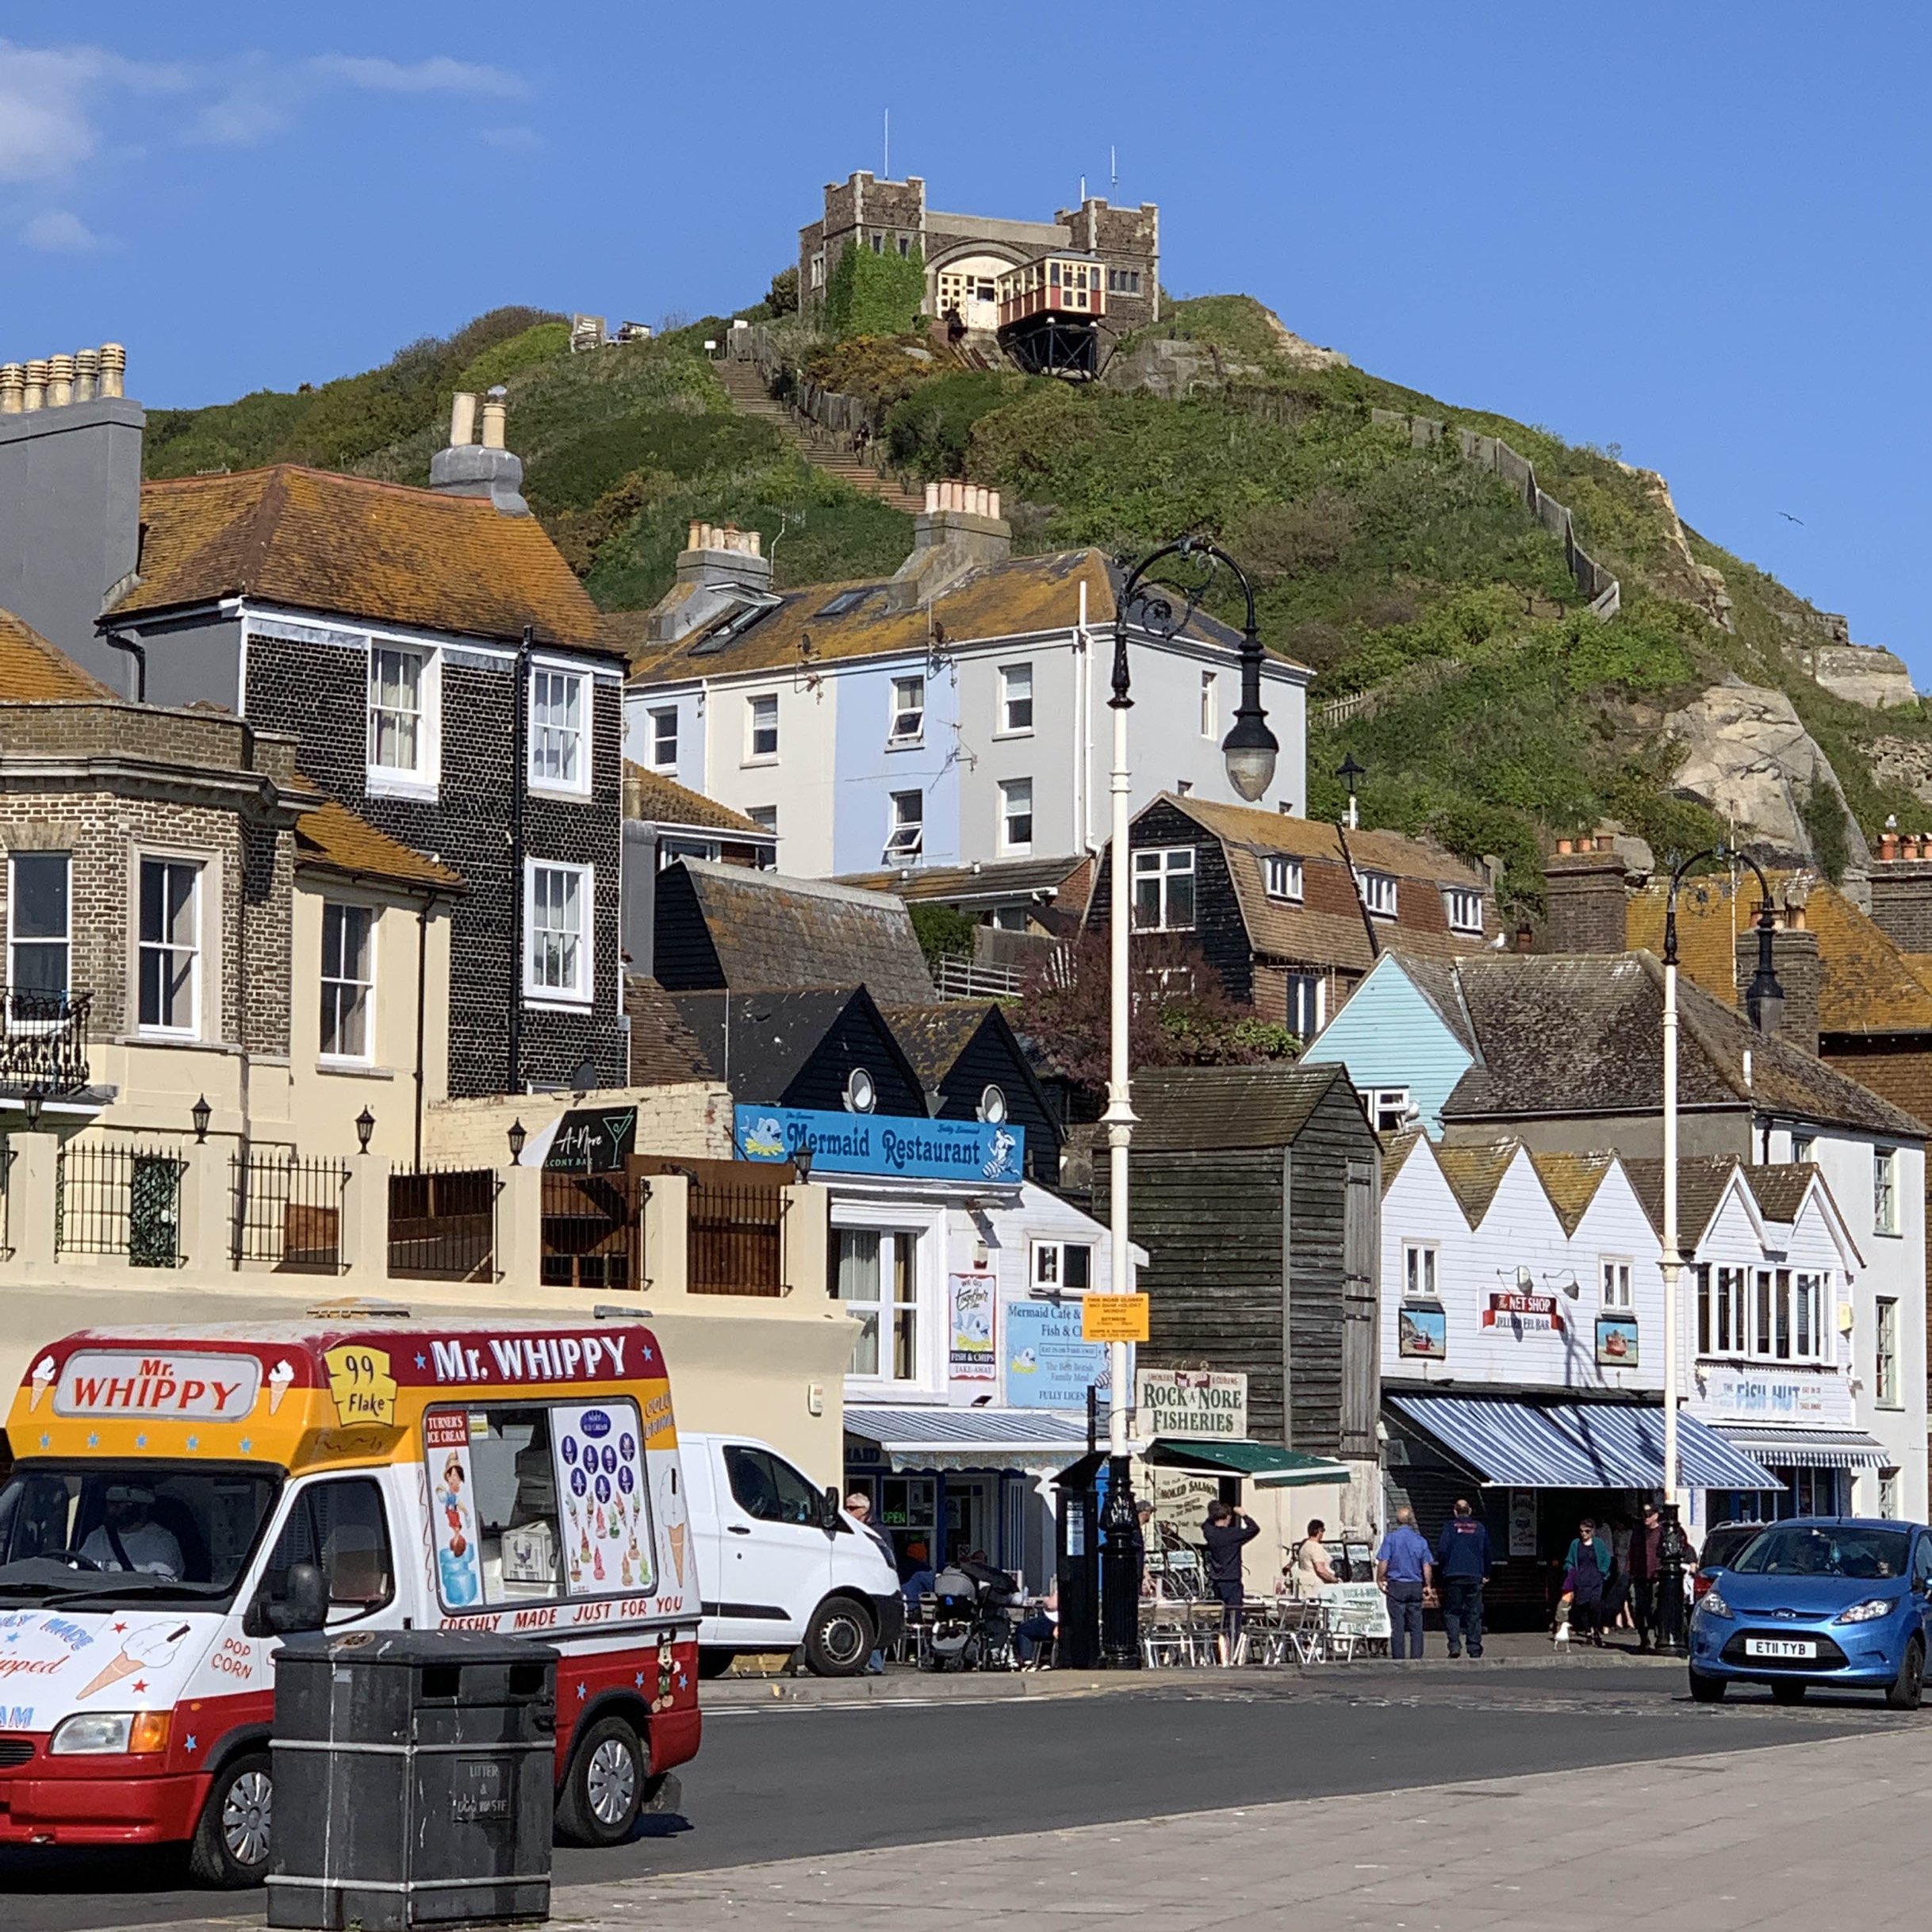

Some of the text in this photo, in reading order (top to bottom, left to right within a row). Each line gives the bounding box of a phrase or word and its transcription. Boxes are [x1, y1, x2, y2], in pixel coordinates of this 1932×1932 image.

[787, 1122, 980, 1170] Mermaid Restaurant
[1008, 1305, 1048, 1318] Mermaid
[1073, 1309, 1081, 1319] &
[1509, 1296, 1526, 1310] NET
[1528, 1297, 1551, 1312] SHOP
[1041, 1324, 1060, 1336] Fish
[1062, 1325, 1071, 1336] &
[1535, 1319, 1550, 1331] BAR
[430, 1336, 626, 1381] Mr. WHIPPY
[951, 1352, 967, 1361] FISH
[139, 1359, 174, 1376] Mr.
[346, 1355, 374, 1386] 99
[74, 1377, 242, 1412] WHIPPY
[1039, 1391, 1062, 1400] FULLY
[1143, 1383, 1242, 1409] ROCK A NORE
[349, 1393, 385, 1417] Flake
[1152, 1410, 1233, 1432] FISHERIES
[427, 1430, 467, 1443] ICE CREAM
[1155, 1484, 1186, 1500] SMOKED
[882, 1511, 906, 1524] OPEN
[516, 1608, 557, 1627] MADE
[573, 1604, 611, 1622] JUST
[621, 1600, 646, 1617] FOR
[657, 1596, 683, 1612] YOU
[40, 1618, 94, 1651] MADE
[224, 1638, 251, 1657] POP
[1782, 1643, 1806, 1655] TYB
[212, 1654, 252, 1679] CORN
[470, 1765, 499, 1777] LITTER
